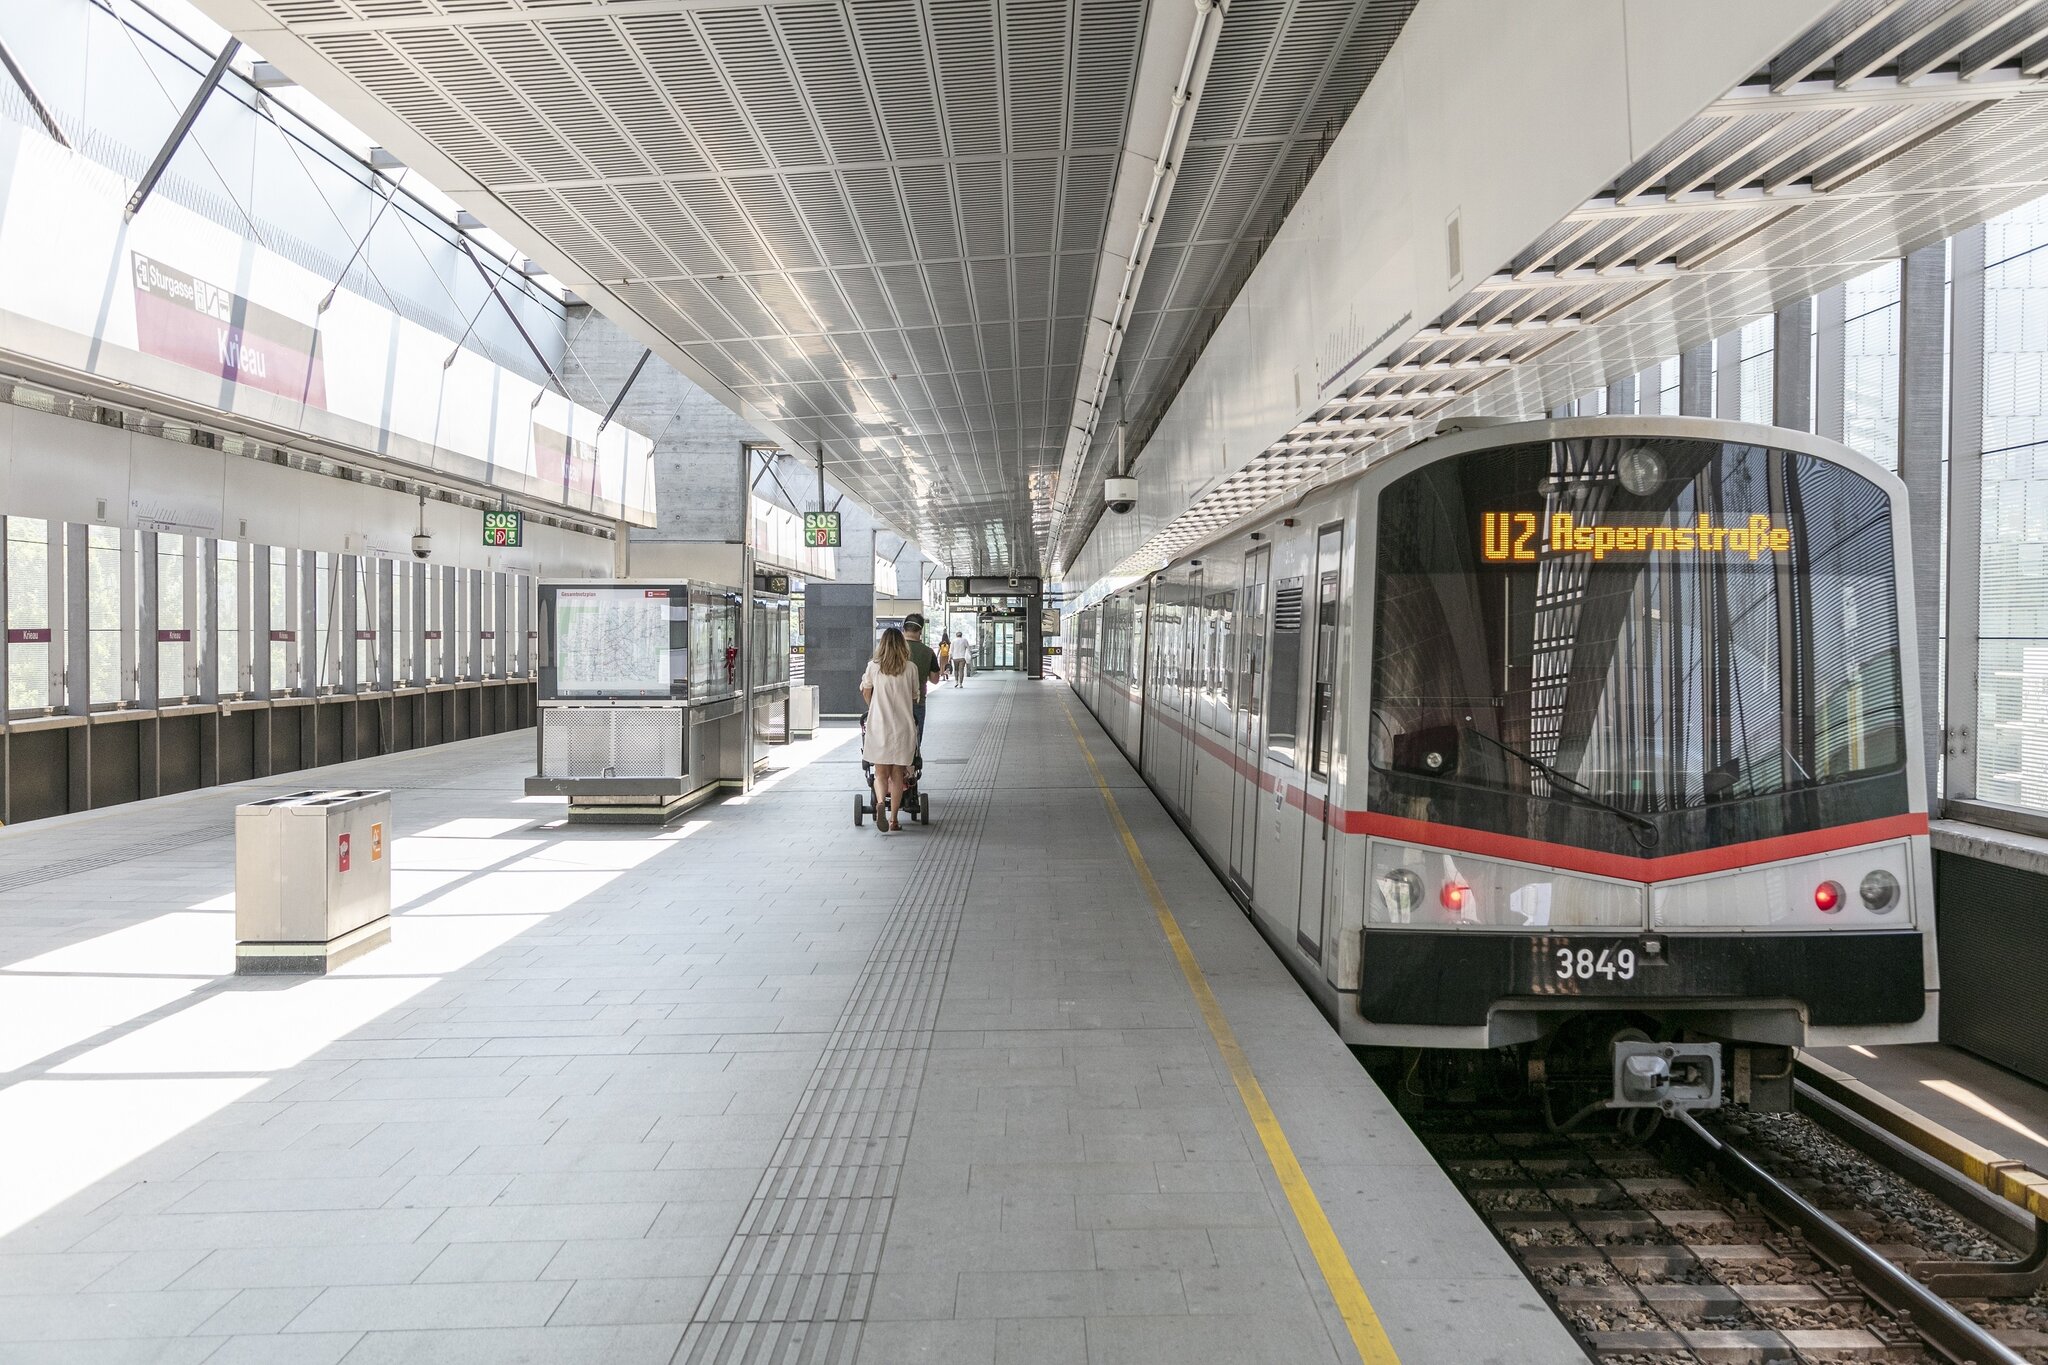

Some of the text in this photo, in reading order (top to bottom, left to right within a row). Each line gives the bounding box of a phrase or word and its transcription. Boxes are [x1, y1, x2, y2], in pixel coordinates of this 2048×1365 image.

[150, 265, 194, 300] Sturgasse
[217, 327, 266, 378] Krieau
[485, 513, 517, 528] SOS
[806, 514, 837, 528] SOS
[1485, 513, 1790, 560] U2 Aspernstraße
[23, 630, 38, 640] Krieau
[169, 631, 181, 639] Krieau
[1556, 948, 1635, 980] 3849
